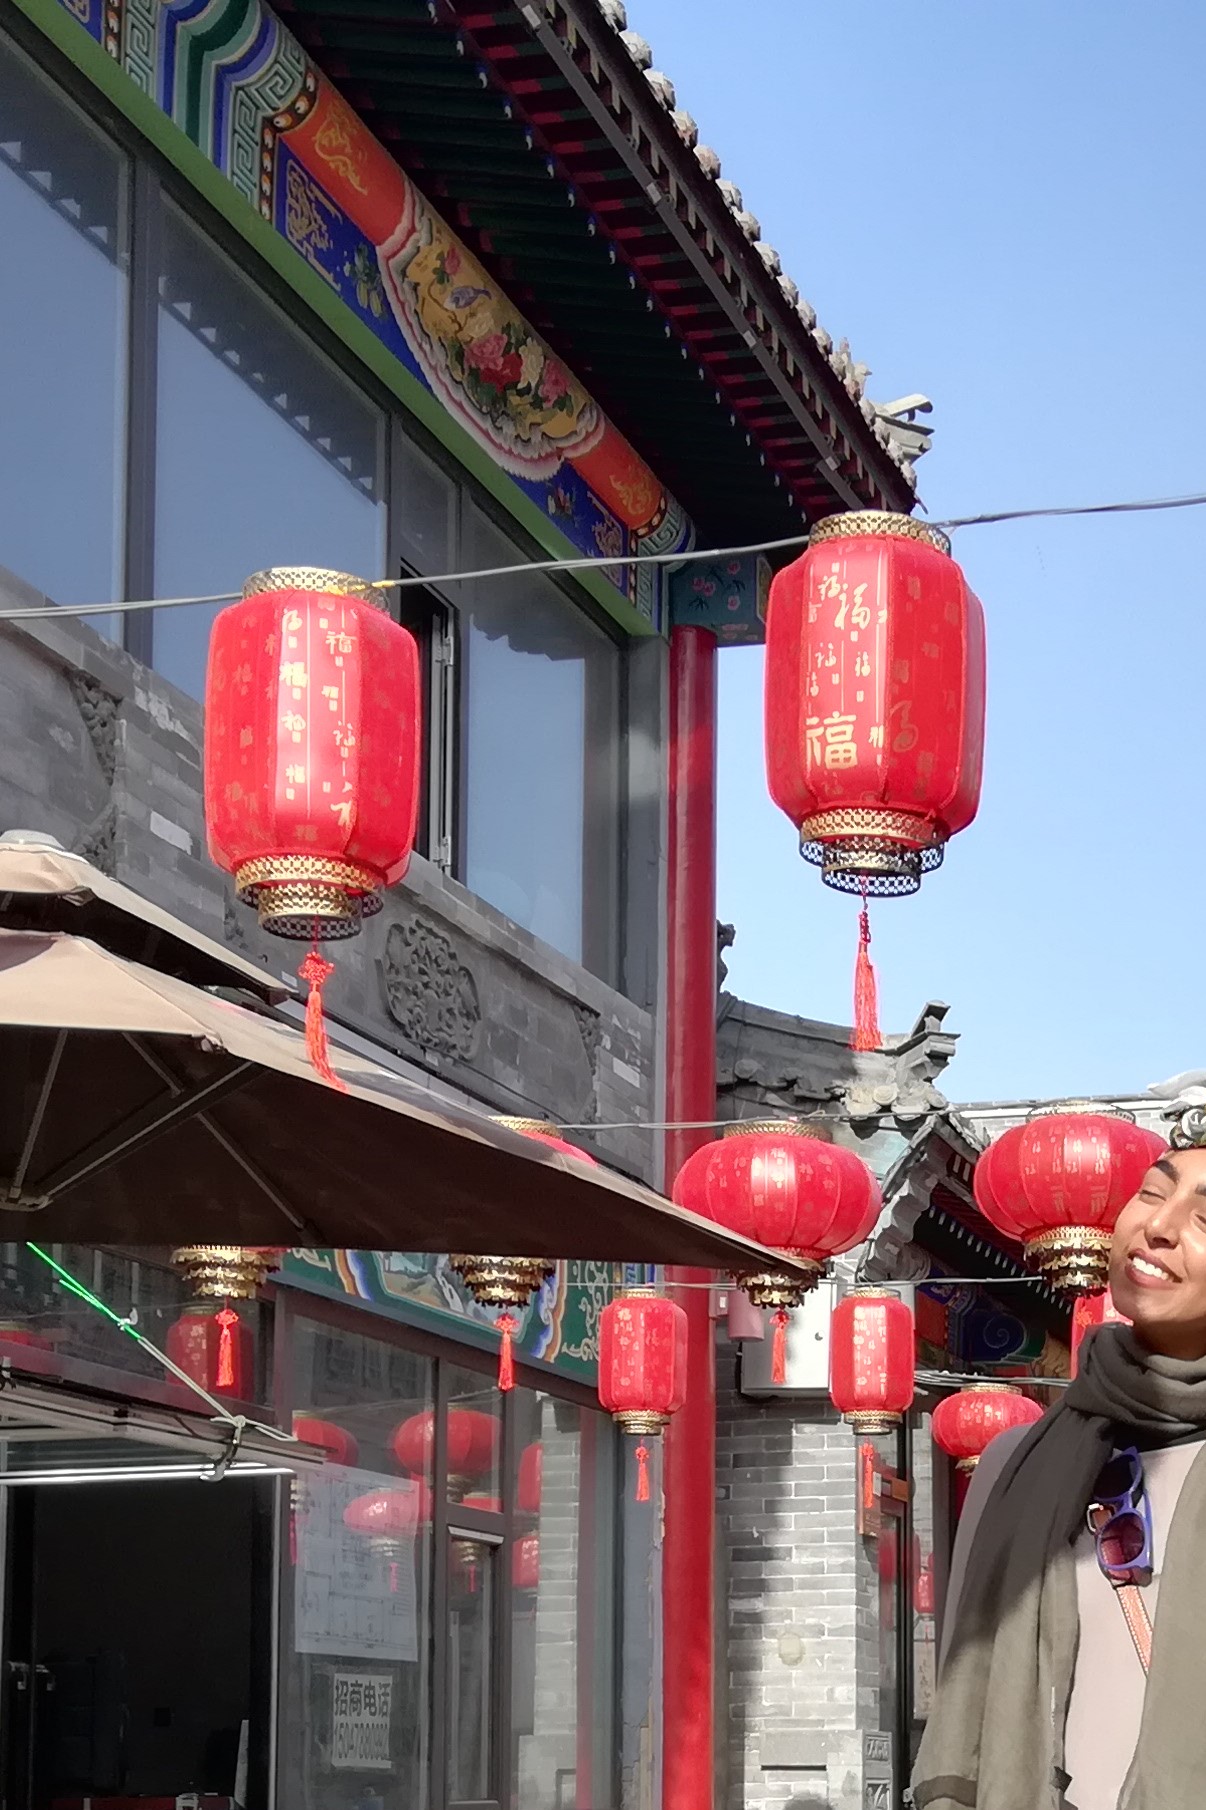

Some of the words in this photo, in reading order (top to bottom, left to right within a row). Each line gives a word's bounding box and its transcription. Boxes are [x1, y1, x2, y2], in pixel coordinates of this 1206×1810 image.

[834, 583, 871, 631] 福
[325, 630, 356, 655] 福
[807, 711, 857, 770] 福
[335, 1679, 391, 1717] 招商电话
